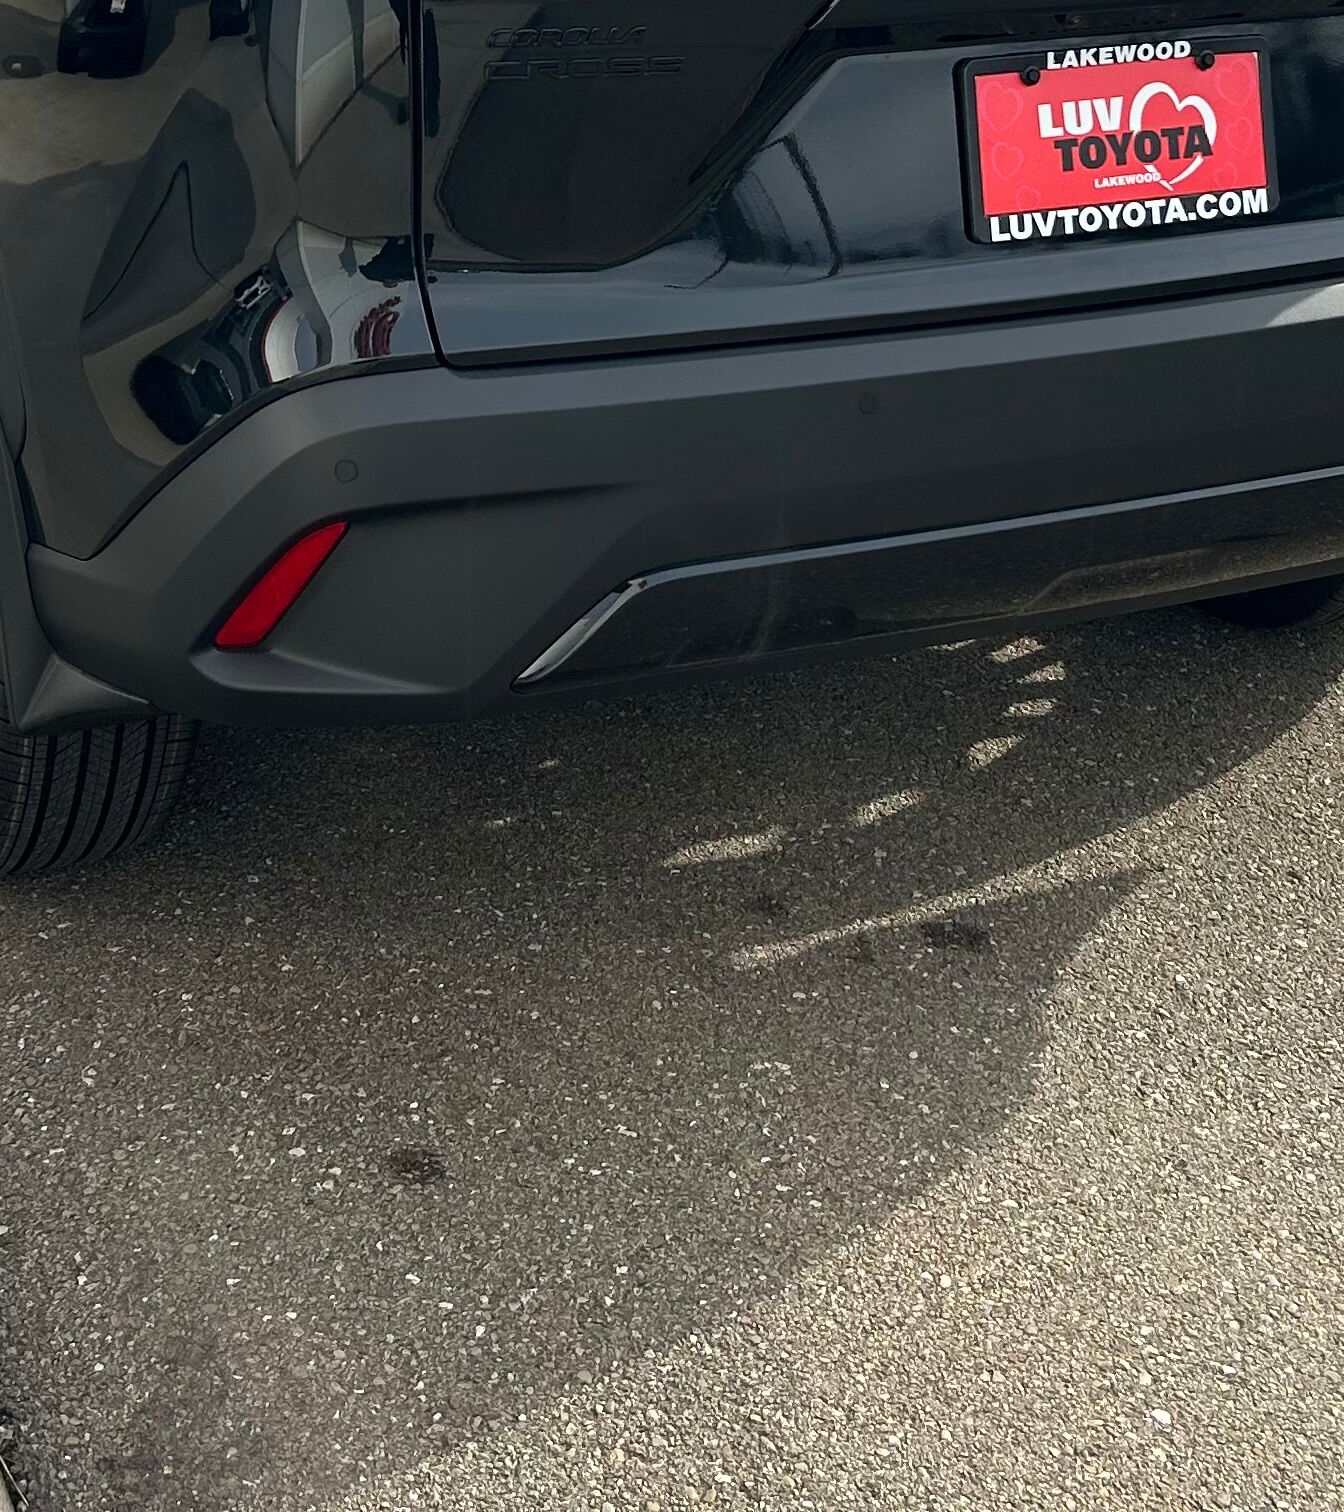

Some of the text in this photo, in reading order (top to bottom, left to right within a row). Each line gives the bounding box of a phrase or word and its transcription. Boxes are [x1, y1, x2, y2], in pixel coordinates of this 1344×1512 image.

[486, 26, 647, 48] COROLLA
[484, 56, 685, 80] CROSS
[1047, 41, 1192, 70] LAKEWOOD
[1038, 96, 1124, 138] LUV
[1055, 125, 1213, 172] TOYOTA
[1094, 172, 1162, 189] LAKEWOOD
[990, 188, 1268, 242] LUVTOYOTA.COM
